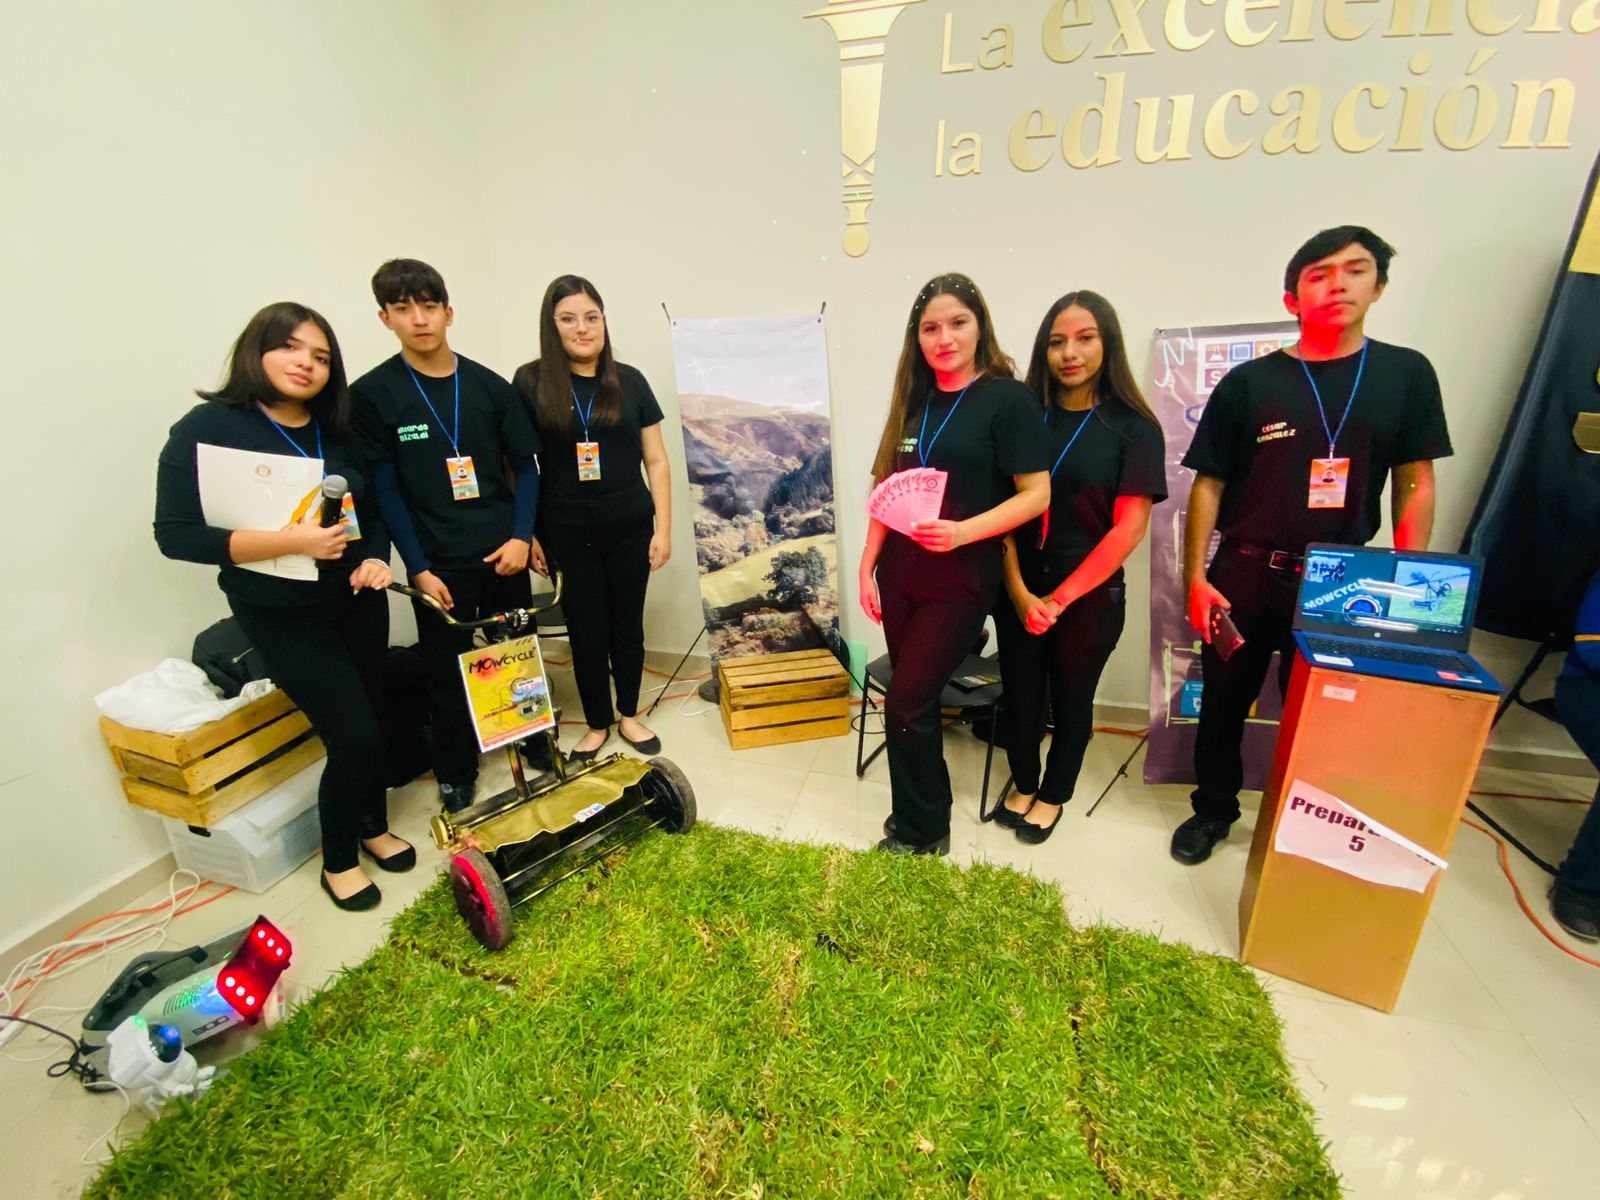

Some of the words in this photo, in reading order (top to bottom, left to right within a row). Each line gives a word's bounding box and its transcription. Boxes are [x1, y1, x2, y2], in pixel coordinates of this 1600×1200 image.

[941, 12, 1015, 74] La
[934, 119, 982, 178] la
[1008, 48, 1577, 172] educación
[1348, 834, 1366, 852] 5
